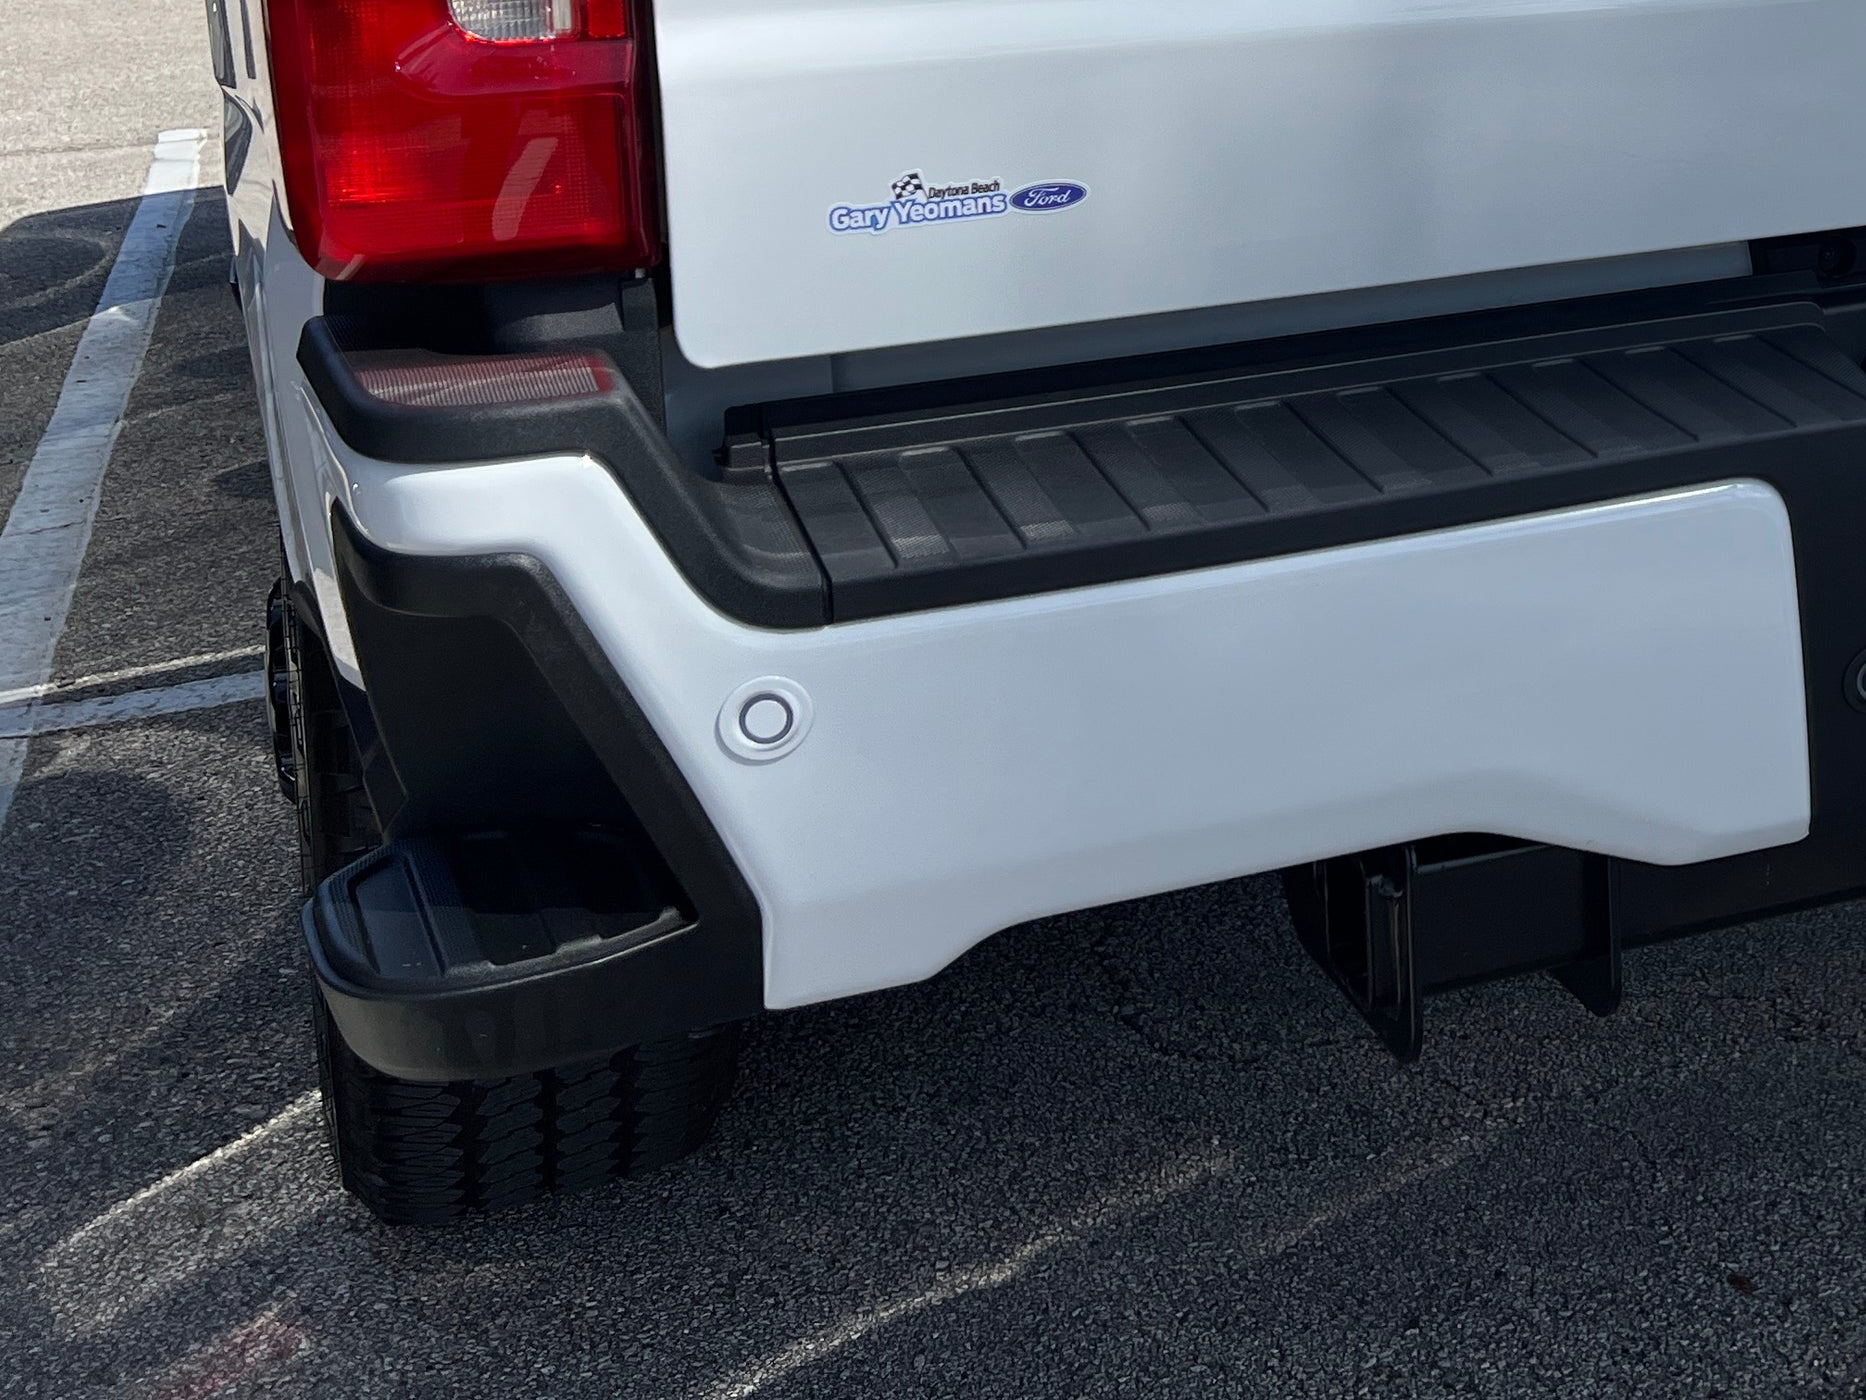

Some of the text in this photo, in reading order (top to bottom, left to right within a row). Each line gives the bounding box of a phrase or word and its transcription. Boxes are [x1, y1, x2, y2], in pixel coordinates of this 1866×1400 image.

[928, 179, 1000, 200] Daytona Beach
[1024, 186, 1071, 207] Ford
[830, 193, 1007, 231] Gary Yeomans
